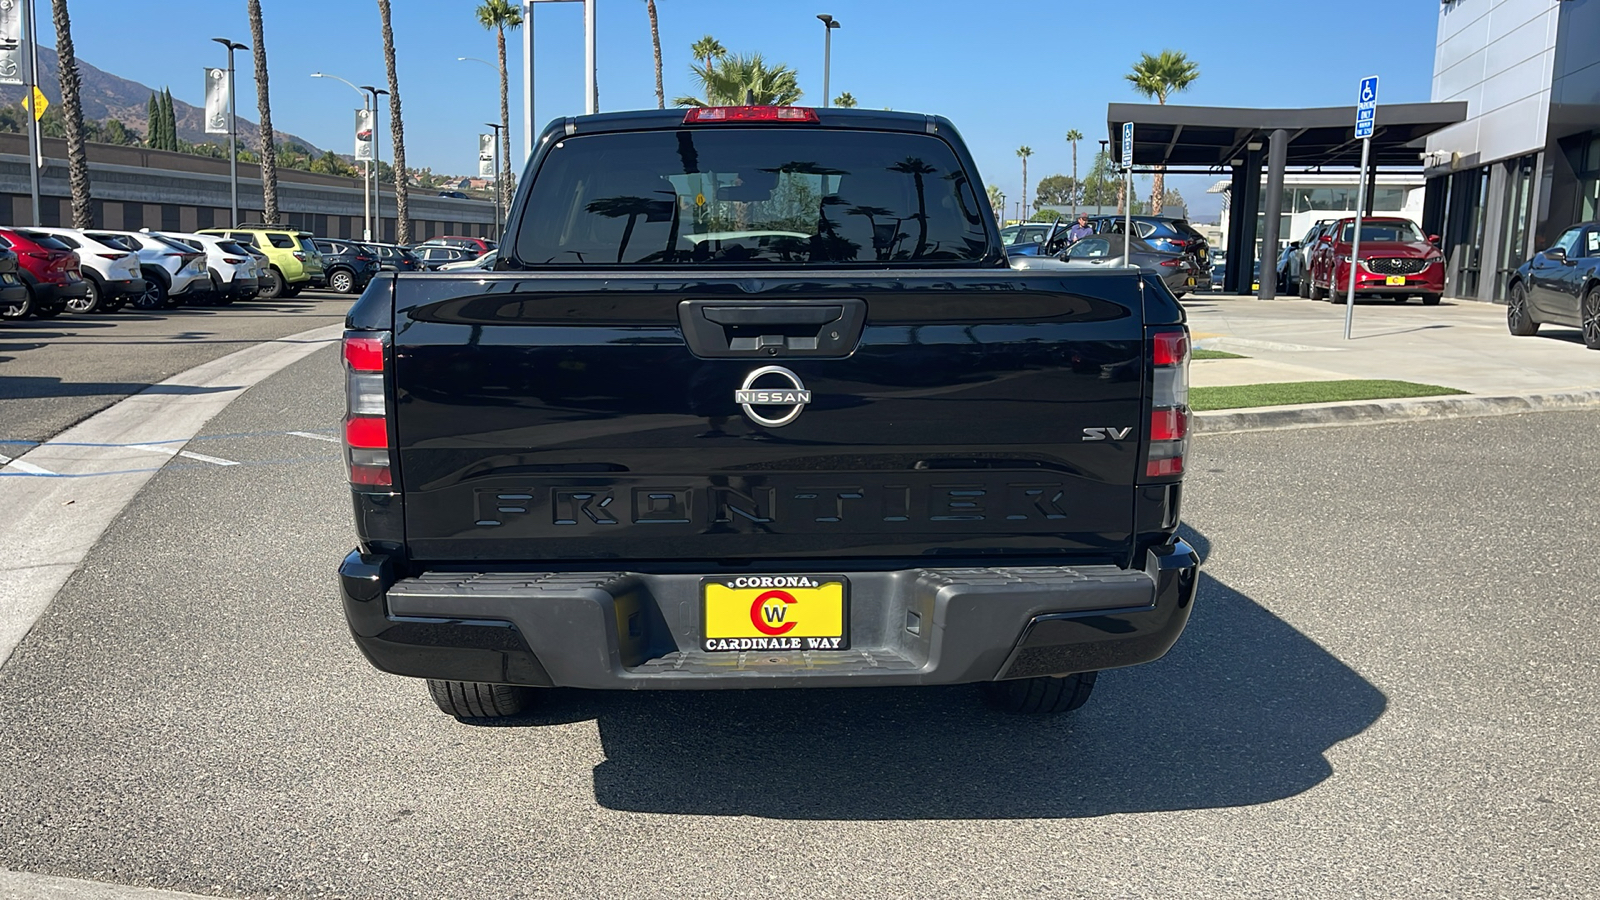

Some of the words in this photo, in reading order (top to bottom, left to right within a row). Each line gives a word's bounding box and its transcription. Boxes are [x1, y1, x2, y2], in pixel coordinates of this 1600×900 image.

[738, 392, 809, 402] NISSAN
[1082, 427, 1132, 441] SV
[473, 481, 1068, 526] FRONTIER
[735, 576, 811, 588] CORONA
[706, 638, 801, 650] CARDINALE
[808, 637, 841, 648] WAY
